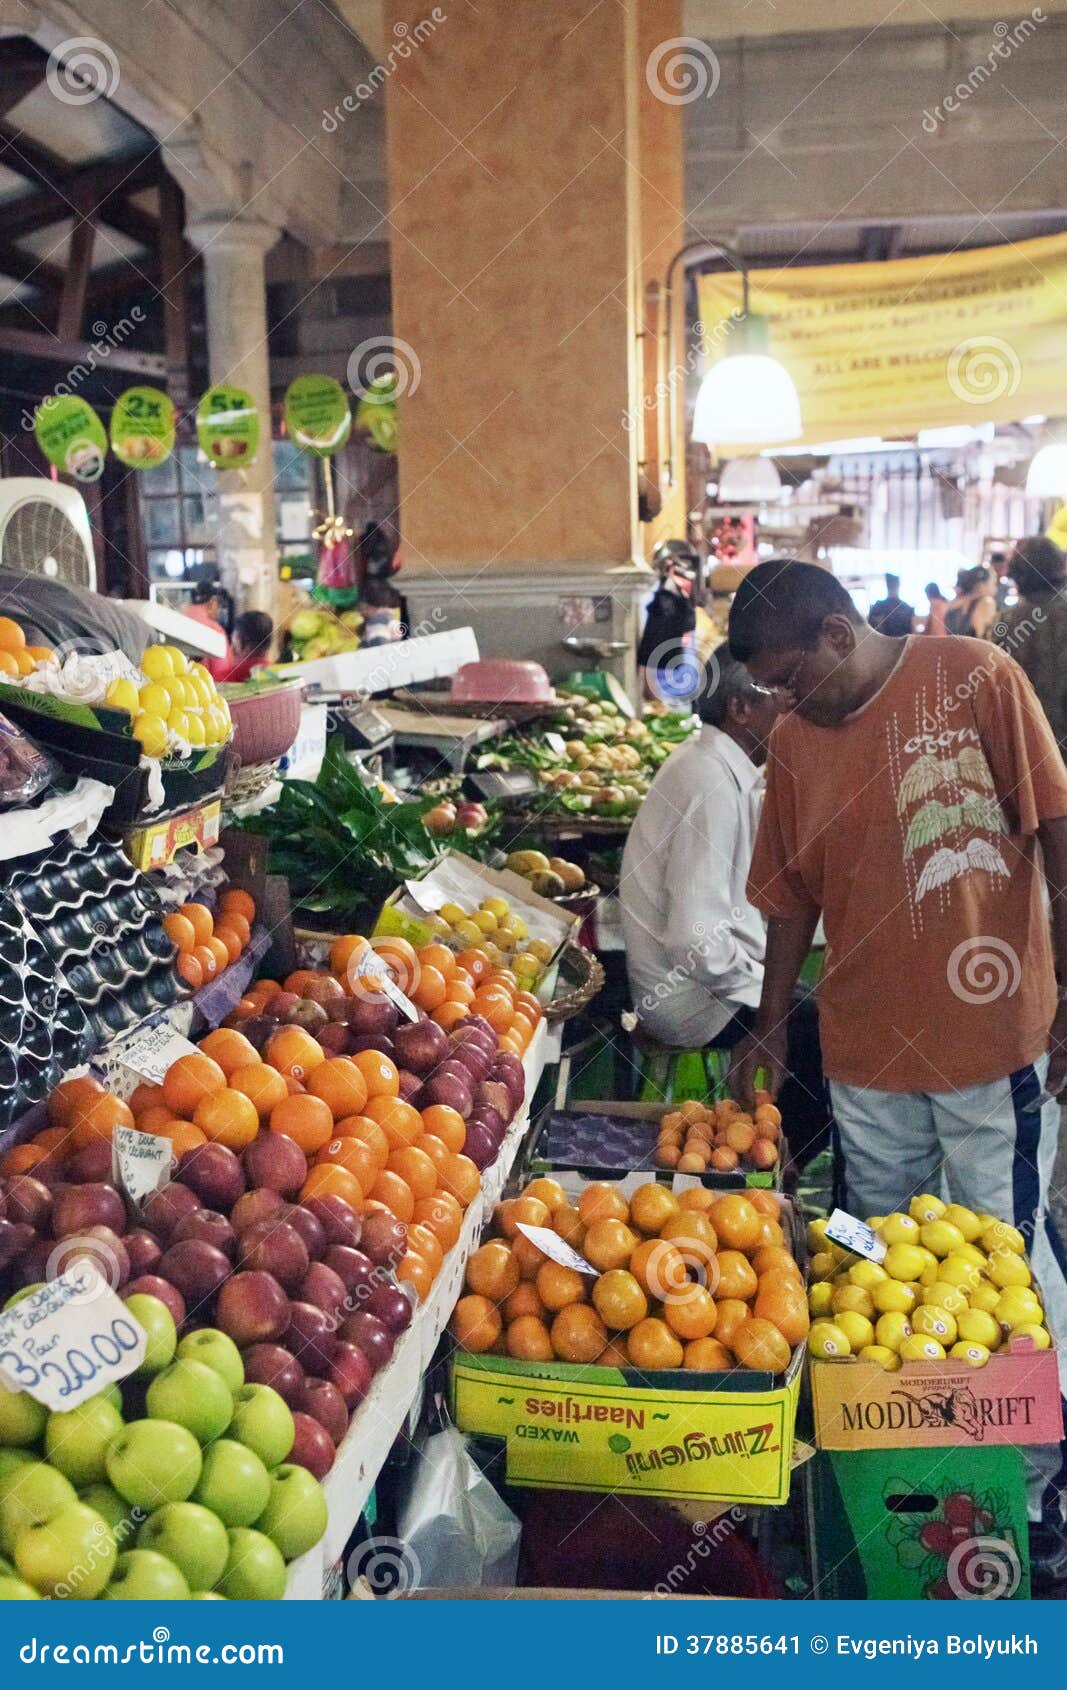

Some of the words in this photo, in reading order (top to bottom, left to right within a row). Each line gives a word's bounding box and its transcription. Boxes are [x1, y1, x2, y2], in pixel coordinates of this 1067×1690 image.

[41, 1318, 139, 1396] 20.00
[525, 1397, 646, 1431] Naartjies
[841, 1396, 1036, 1431] MODDERIFT
[515, 1423, 580, 1444] WAXED
